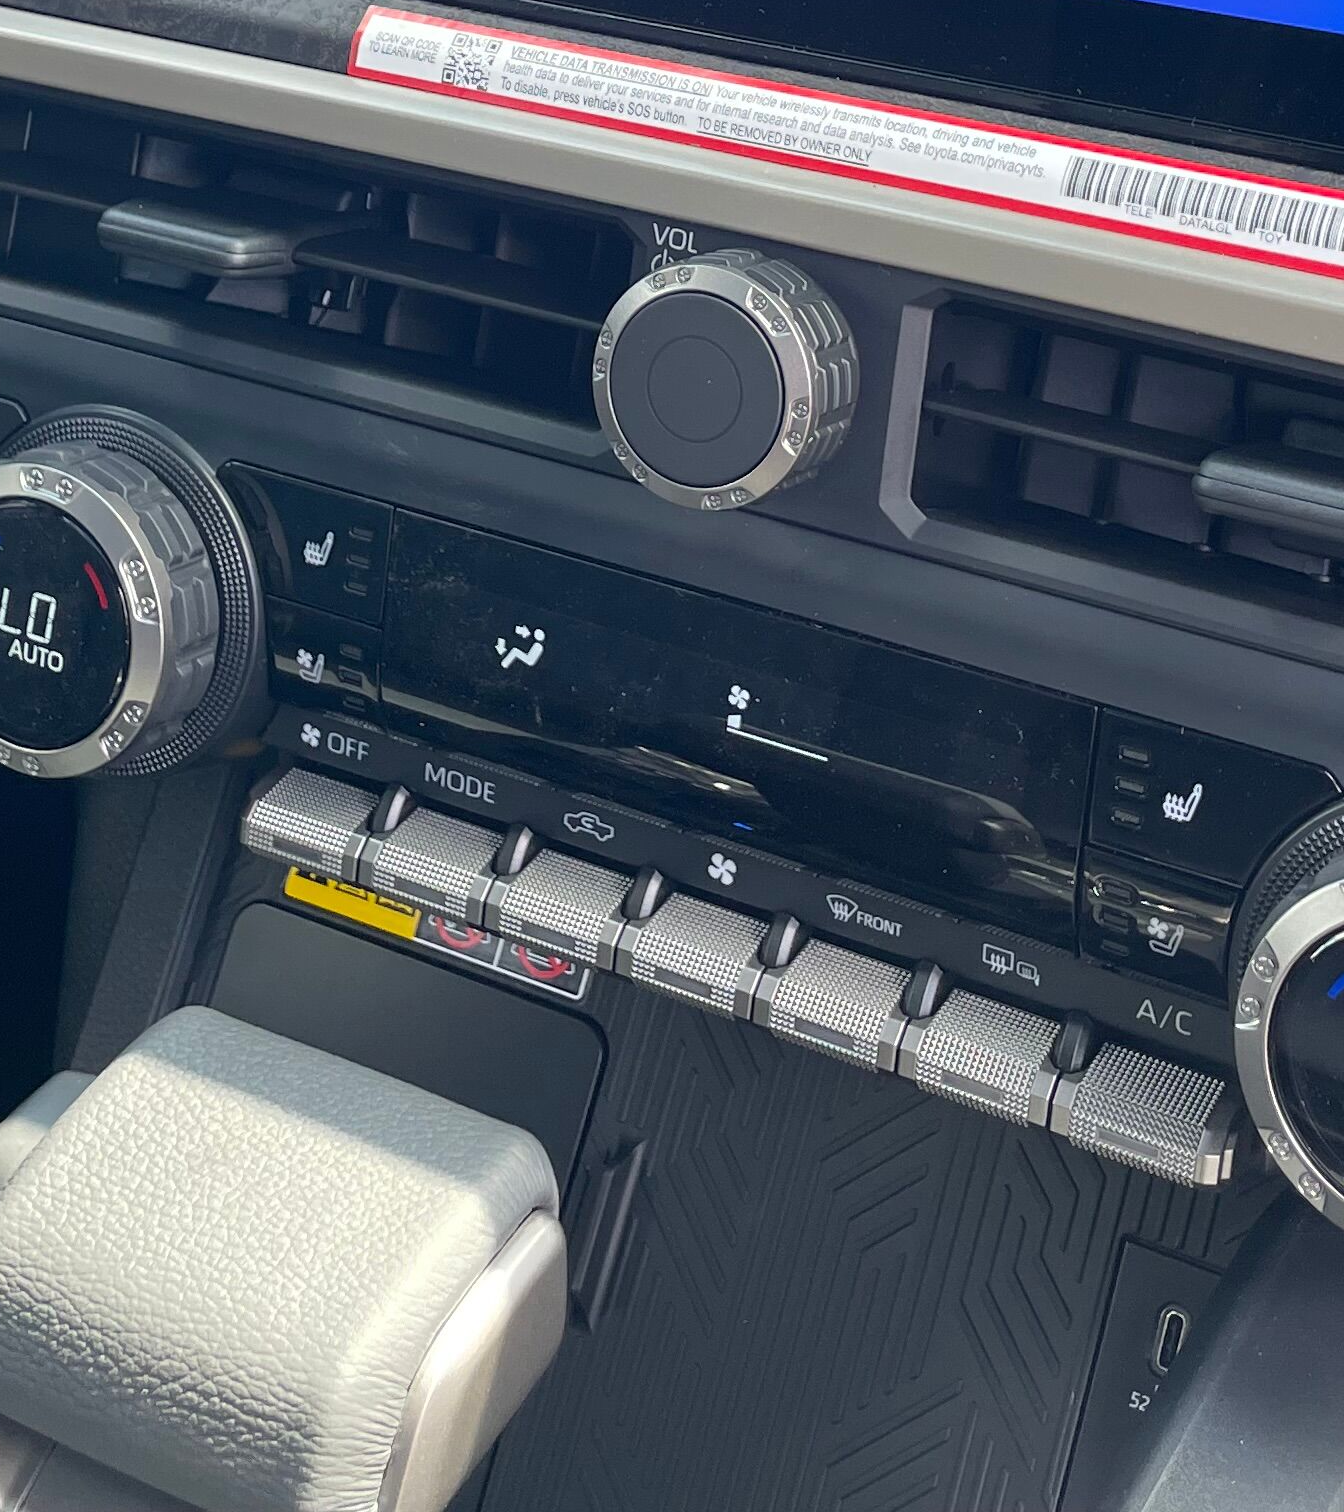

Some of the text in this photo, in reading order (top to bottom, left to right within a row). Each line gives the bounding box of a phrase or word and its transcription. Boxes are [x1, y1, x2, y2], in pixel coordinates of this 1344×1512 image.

[369, 40, 436, 64] TO LEARN MORE
[376, 31, 401, 44] SCAN
[416, 39, 442, 52] CODE
[501, 75, 873, 163] To disable, press vehicle's SOS button. TO BE REMOVED BY OWNER ONLY
[503, 59, 534, 76] health
[536, 68, 557, 82] data
[571, 75, 605, 90] deliver
[606, 83, 628, 98] your
[629, 87, 672, 105] services
[674, 95, 695, 109] and
[696, 98, 712, 111] for
[712, 102, 751, 120] internal
[752, 111, 798, 130] research
[800, 119, 822, 134] and
[823, 123, 847, 139] data
[849, 129, 895, 149] analysis.
[899, 137, 922, 154] See
[511, 45, 557, 65] VEHICLE
[559, 55, 587, 71] DATA
[591, 61, 676, 88] TRANSMISSION
[677, 77, 689, 90] IS
[717, 84, 740, 100] Your
[741, 91, 777, 107] vehicle
[779, 97, 831, 120] wirelessly
[832, 108, 881, 128] transmits
[884, 118, 928, 139] location,
[932, 128, 970, 148] driving
[972, 136, 995, 150] and
[997, 143, 1037, 159] vehicle
[652, 222, 698, 254] VOL
[1124, 203, 1153, 220] TELE
[1258, 230, 1285, 245] TOY
[7, 638, 65, 674] AUTO
[327, 731, 371, 762] OFF
[424, 761, 497, 805] MODE
[856, 909, 904, 938] FRONT
[1136, 997, 1194, 1038] A/C
